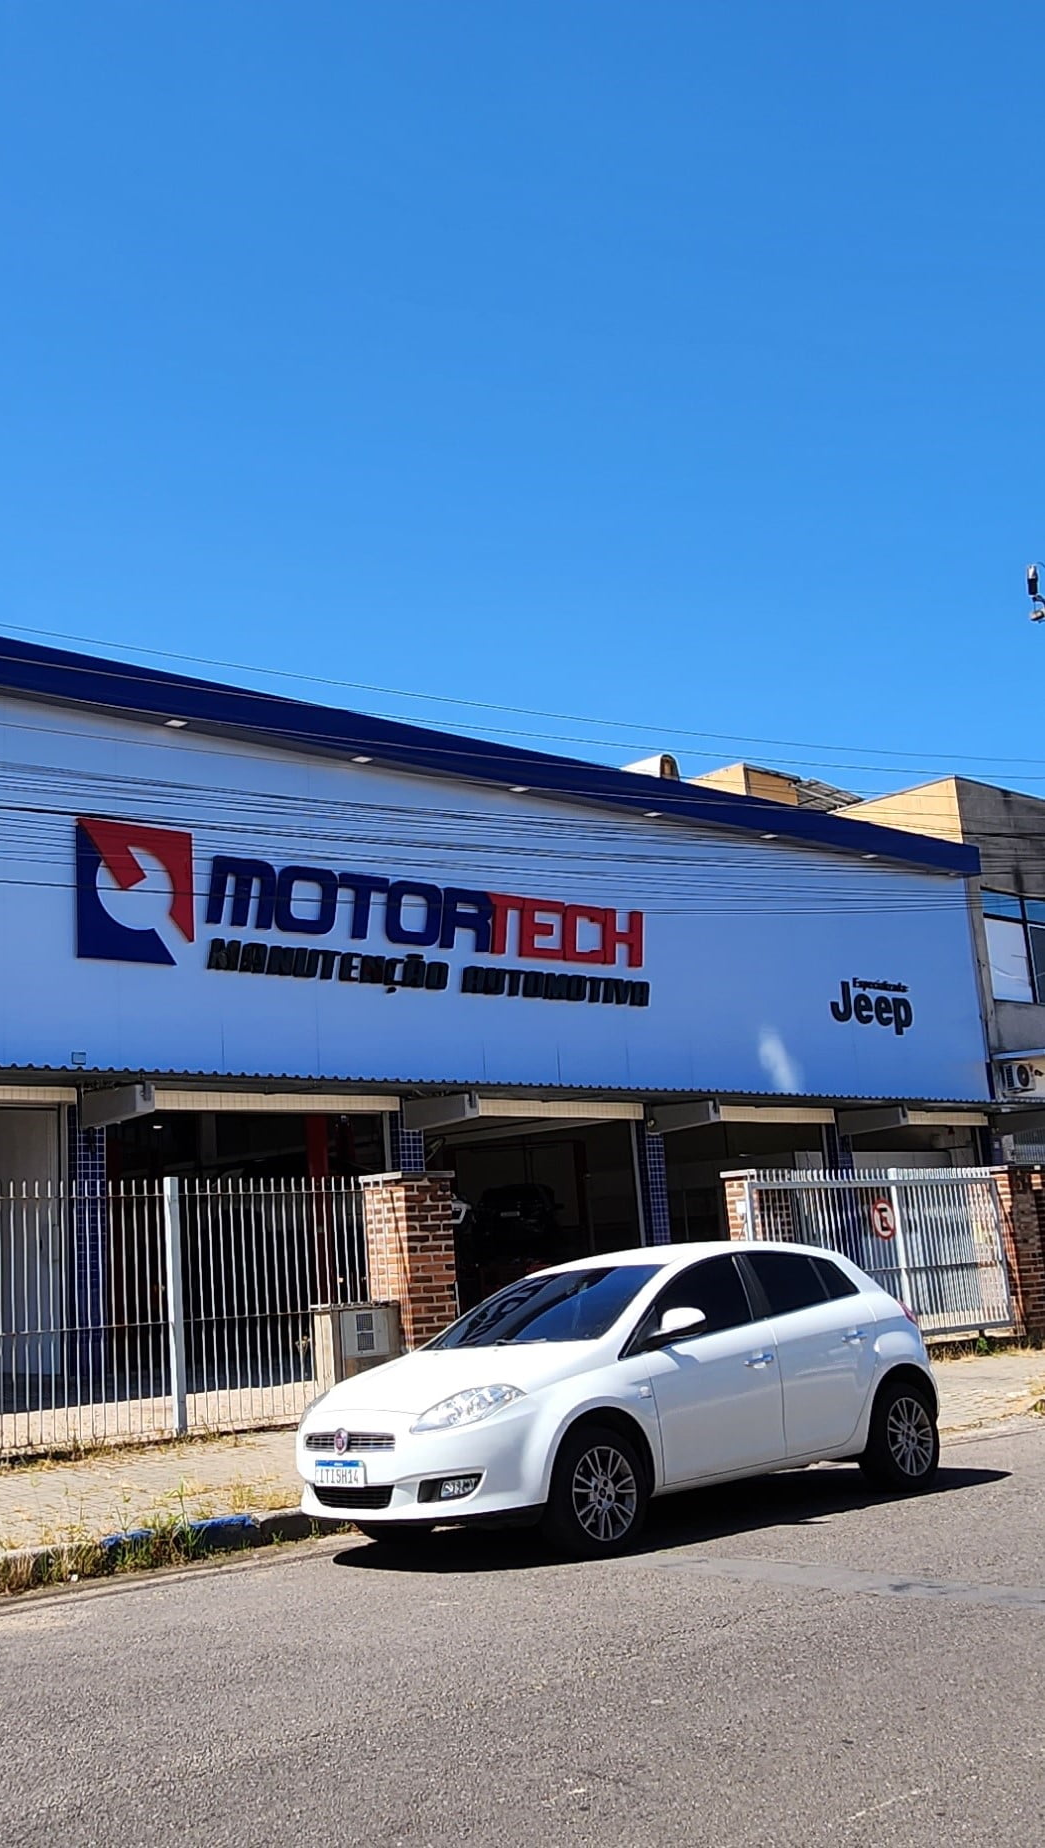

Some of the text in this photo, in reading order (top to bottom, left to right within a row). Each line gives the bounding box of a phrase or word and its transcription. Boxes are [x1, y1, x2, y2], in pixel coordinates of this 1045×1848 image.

[205, 855, 645, 968] MOTORTECH
[206, 938, 651, 1007] MANUTENÇÃO AUTOMOTIVA
[830, 980, 913, 1036] Jeep
